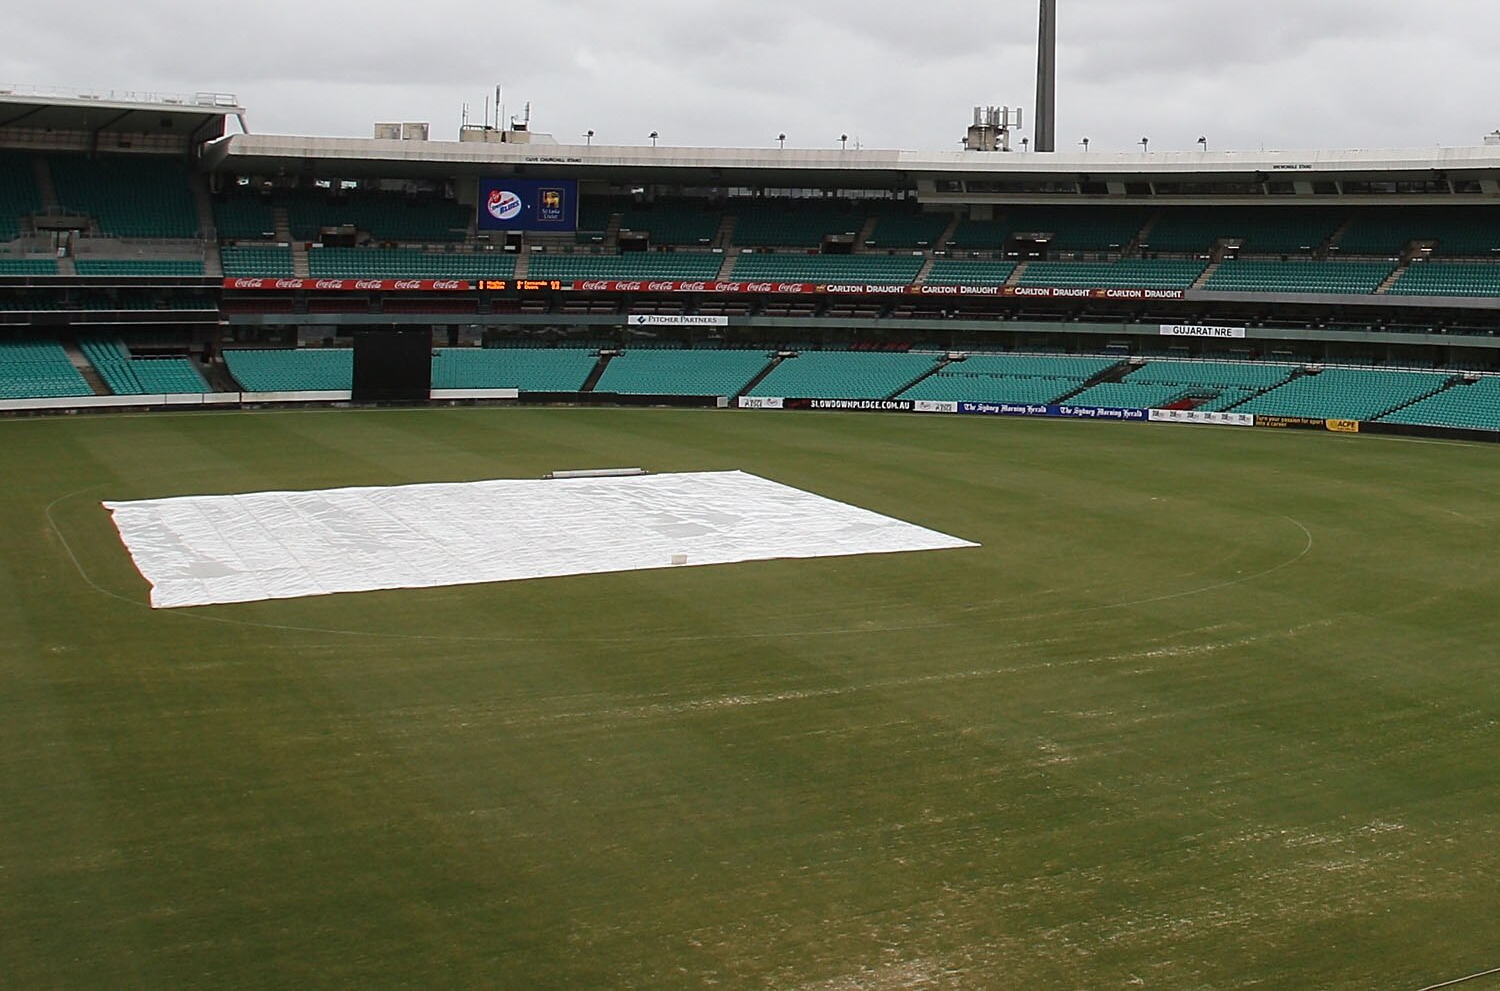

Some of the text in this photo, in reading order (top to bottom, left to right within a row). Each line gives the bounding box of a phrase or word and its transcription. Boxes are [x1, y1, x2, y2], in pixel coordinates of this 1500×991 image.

[827, 285, 905, 293] CARLTON DRAUGHT
[921, 285, 998, 294] CARLTON DRAUGHT
[1014, 287, 1090, 296] CARLTON DRAUGHT
[1107, 289, 1182, 298] CARLTON DRAUGHT
[1172, 326, 1232, 337] GUJARAT NRE
[811, 400, 910, 409] SLOWDOWNPLEDGE.COM.AU
[963, 403, 976, 411] The
[1059, 406, 1072, 414] The
